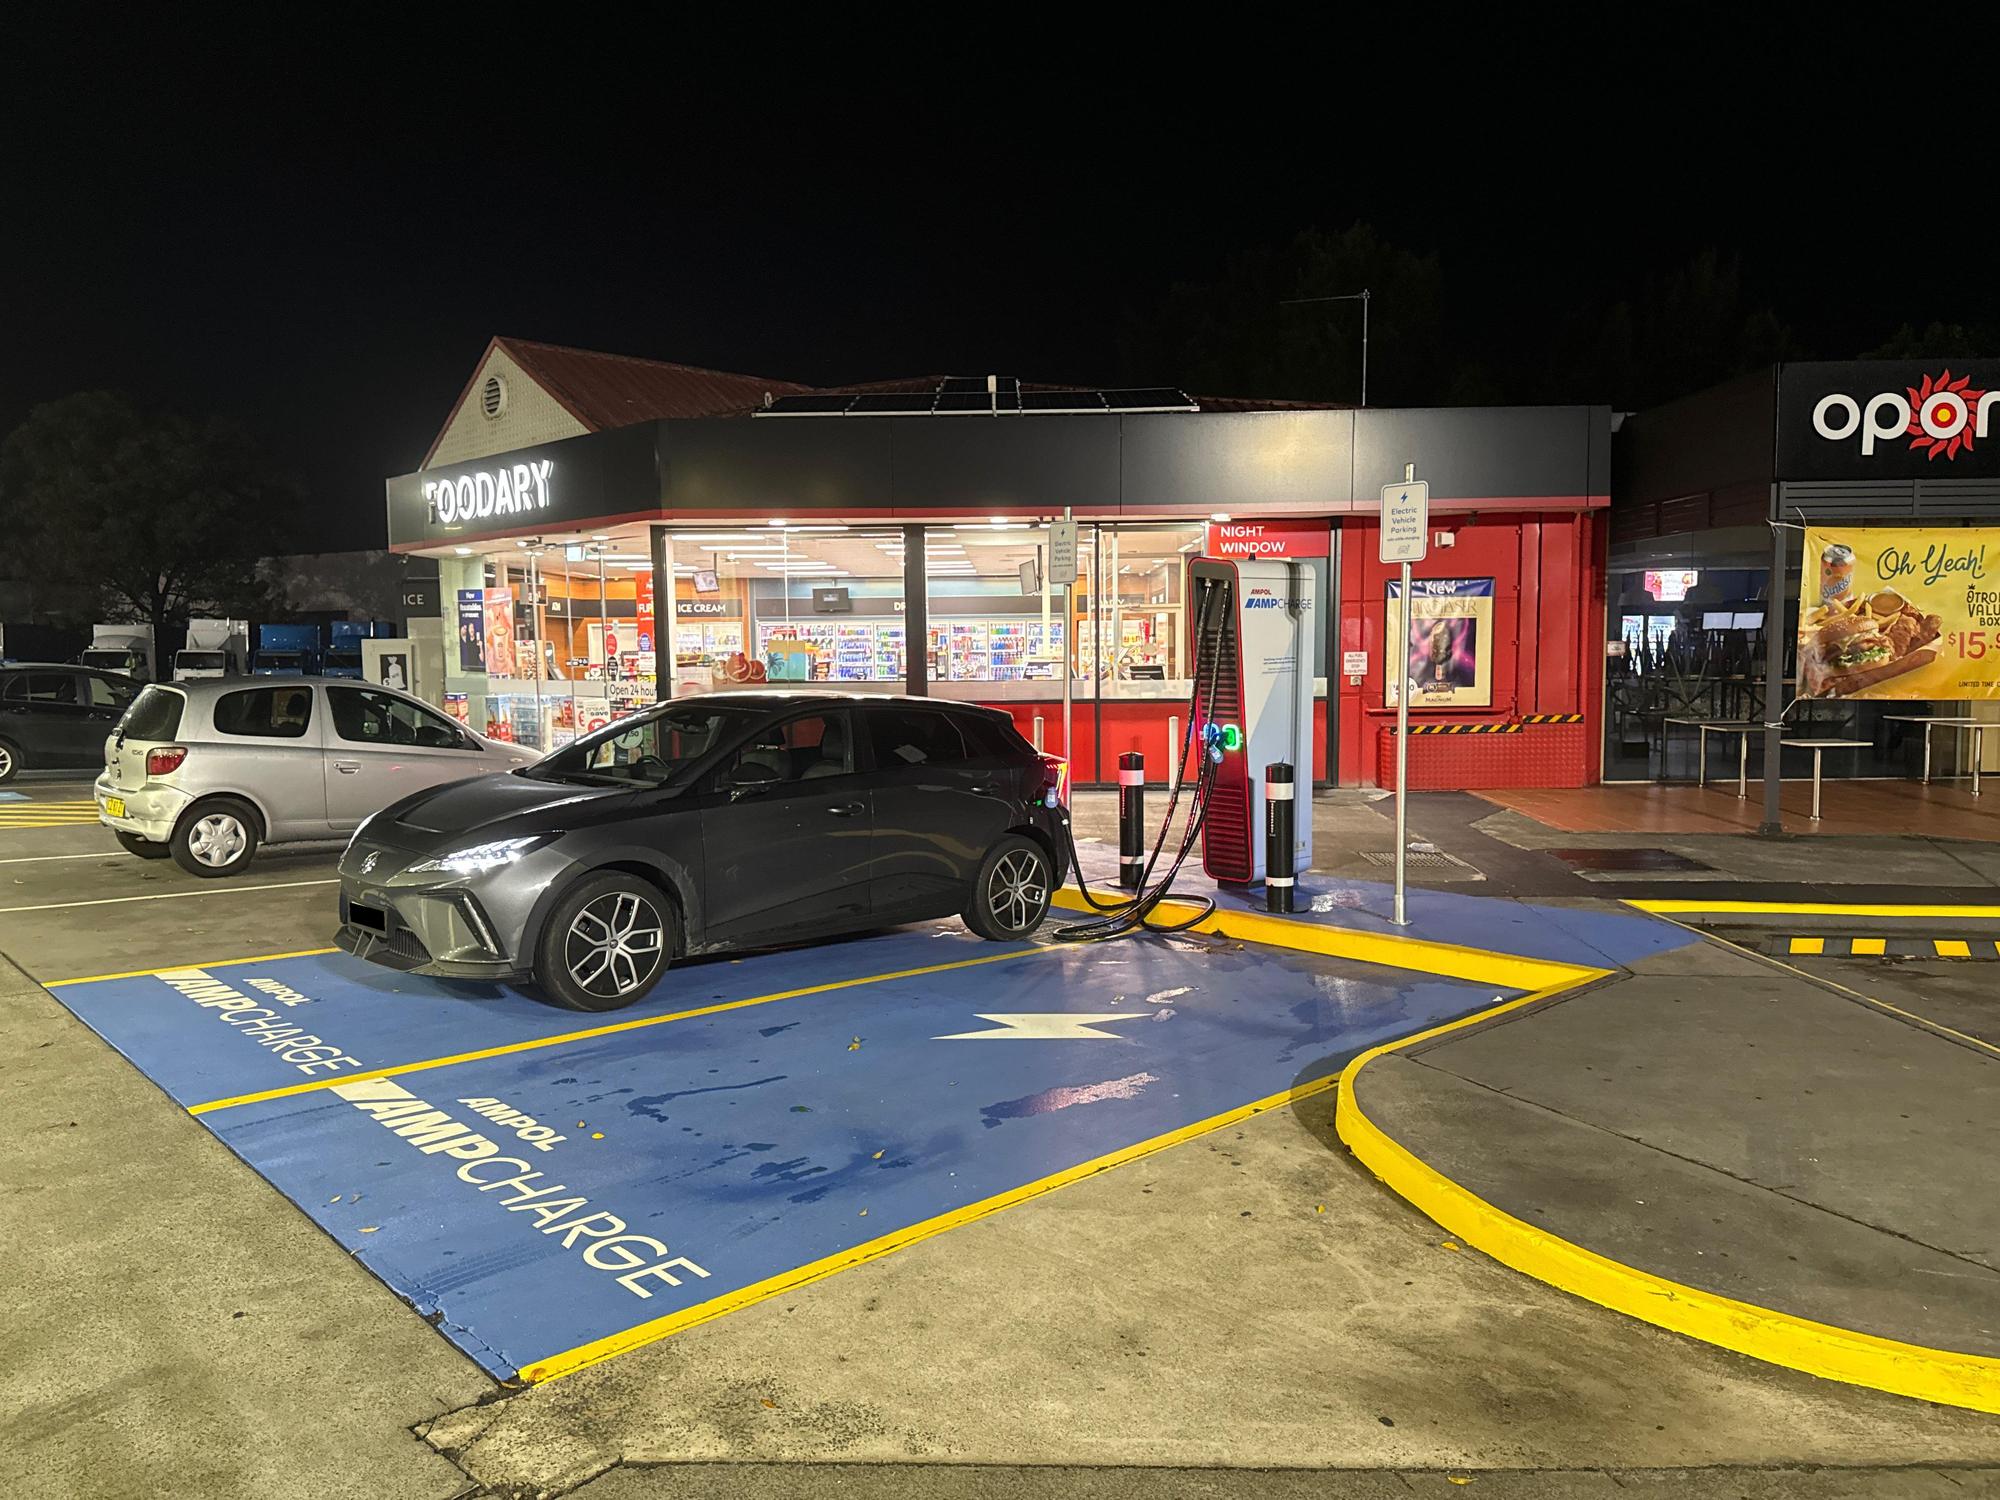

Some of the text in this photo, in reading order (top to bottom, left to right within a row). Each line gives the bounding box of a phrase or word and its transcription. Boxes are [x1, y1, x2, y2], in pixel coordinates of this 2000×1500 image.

[425, 460, 554, 524] FOODARY
[1391, 507, 1418, 516] Electric
[1391, 516, 1417, 525] Vehicle
[1220, 526, 1265, 537] NIGHT
[1391, 526, 1417, 534] Parking
[1220, 541, 1286, 554] WINDOW
[1876, 544, 1986, 586] Oh Yeah!
[1250, 588, 1272, 596] AMPOL
[1425, 583, 1457, 595] New
[402, 594, 425, 605] ICE
[1251, 598, 1312, 610] AMPCHARGE
[677, 603, 726, 613] ICE CREAM
[1980, 617, 2000, 626] BOX
[609, 683, 629, 697] Open
[630, 684, 639, 695] 24
[242, 978, 312, 1007] AMPOL
[163, 978, 363, 1075] AMPCHARGE
[456, 1097, 568, 1152] AMPOL
[352, 1098, 712, 1300] AMPCHARGE
